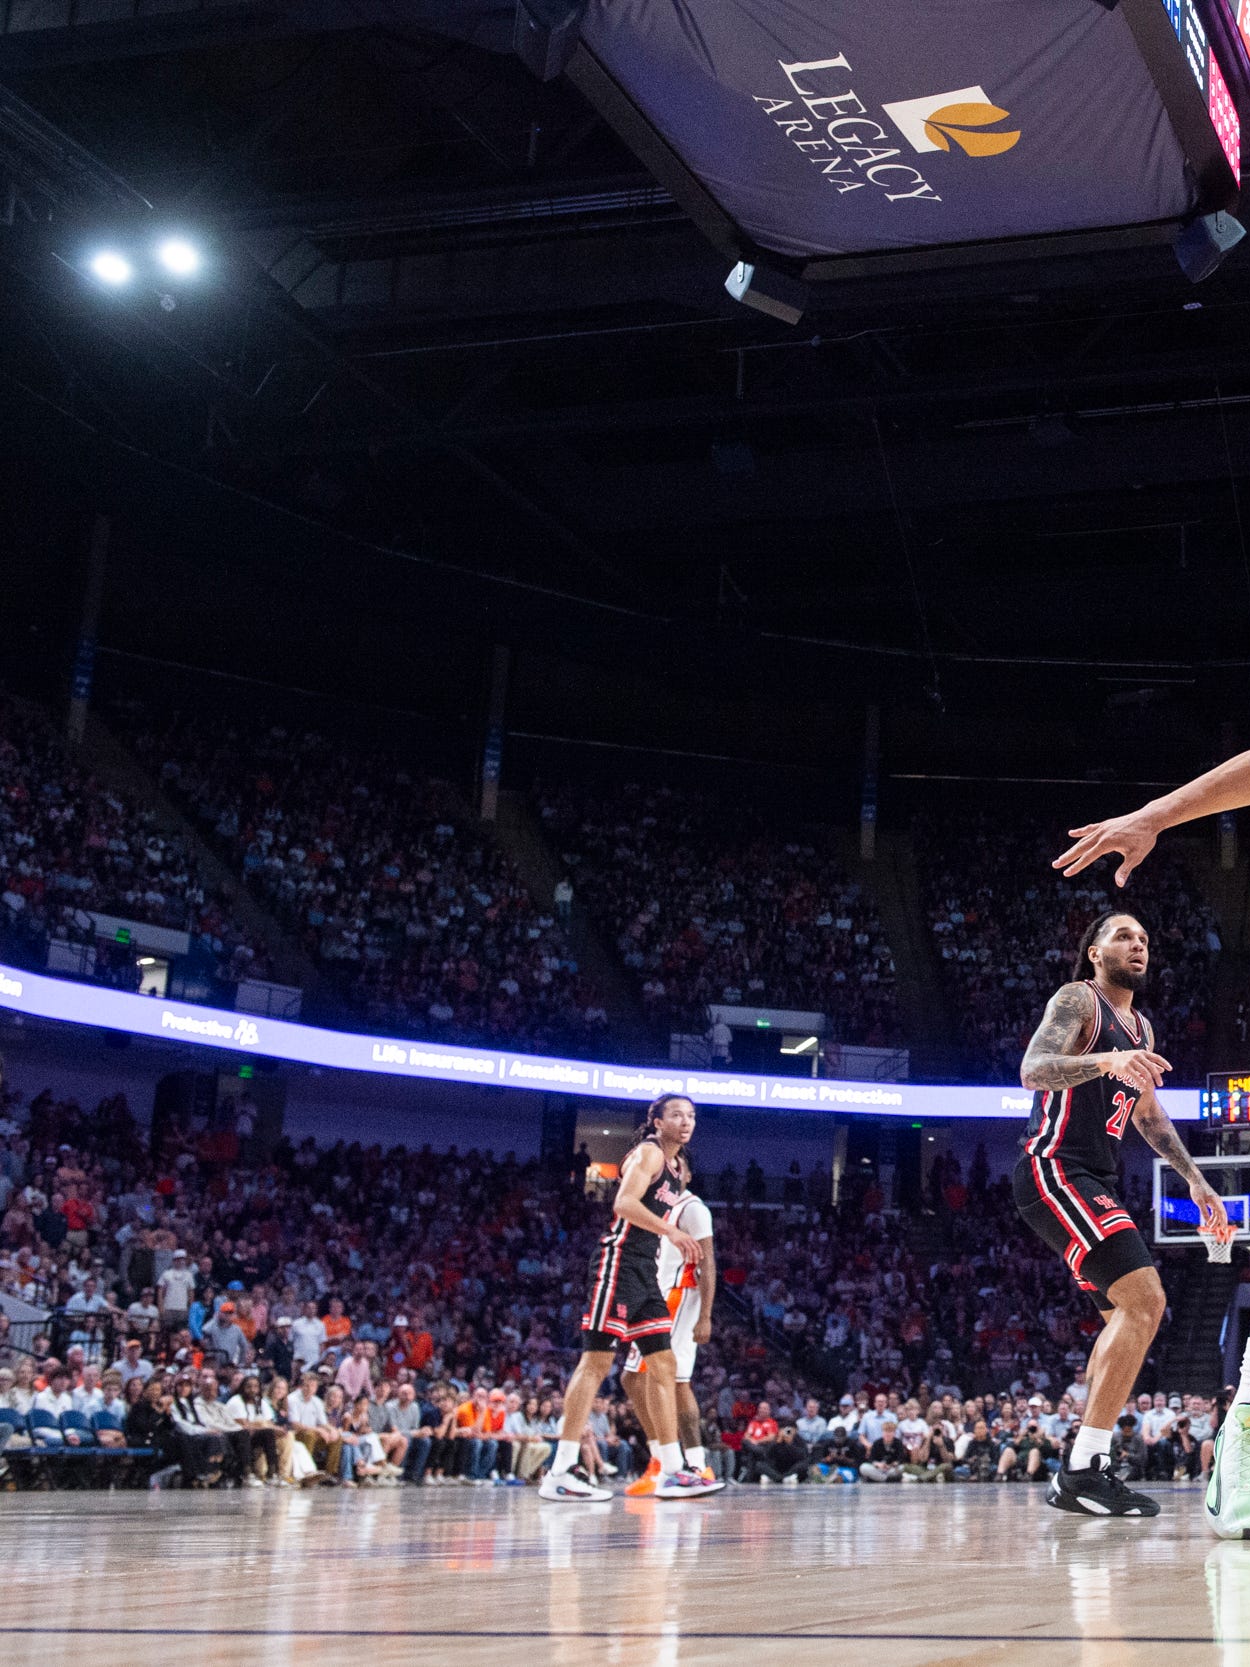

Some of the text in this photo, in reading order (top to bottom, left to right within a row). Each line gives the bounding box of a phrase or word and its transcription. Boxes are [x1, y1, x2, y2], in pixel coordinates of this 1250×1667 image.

[751, 94, 866, 194] ARENA
[777, 51, 943, 202] LEGACY
[162, 1010, 233, 1039] Protective
[372, 1043, 407, 1064] Life
[409, 1048, 495, 1074] Insurance
[509, 1060, 589, 1084] Annuities
[603, 1071, 684, 1095] Employee
[686, 1077, 756, 1097] Benefits
[771, 1082, 817, 1100] Asset
[819, 1085, 903, 1105] Protection
[1106, 1090, 1136, 1141] 21
